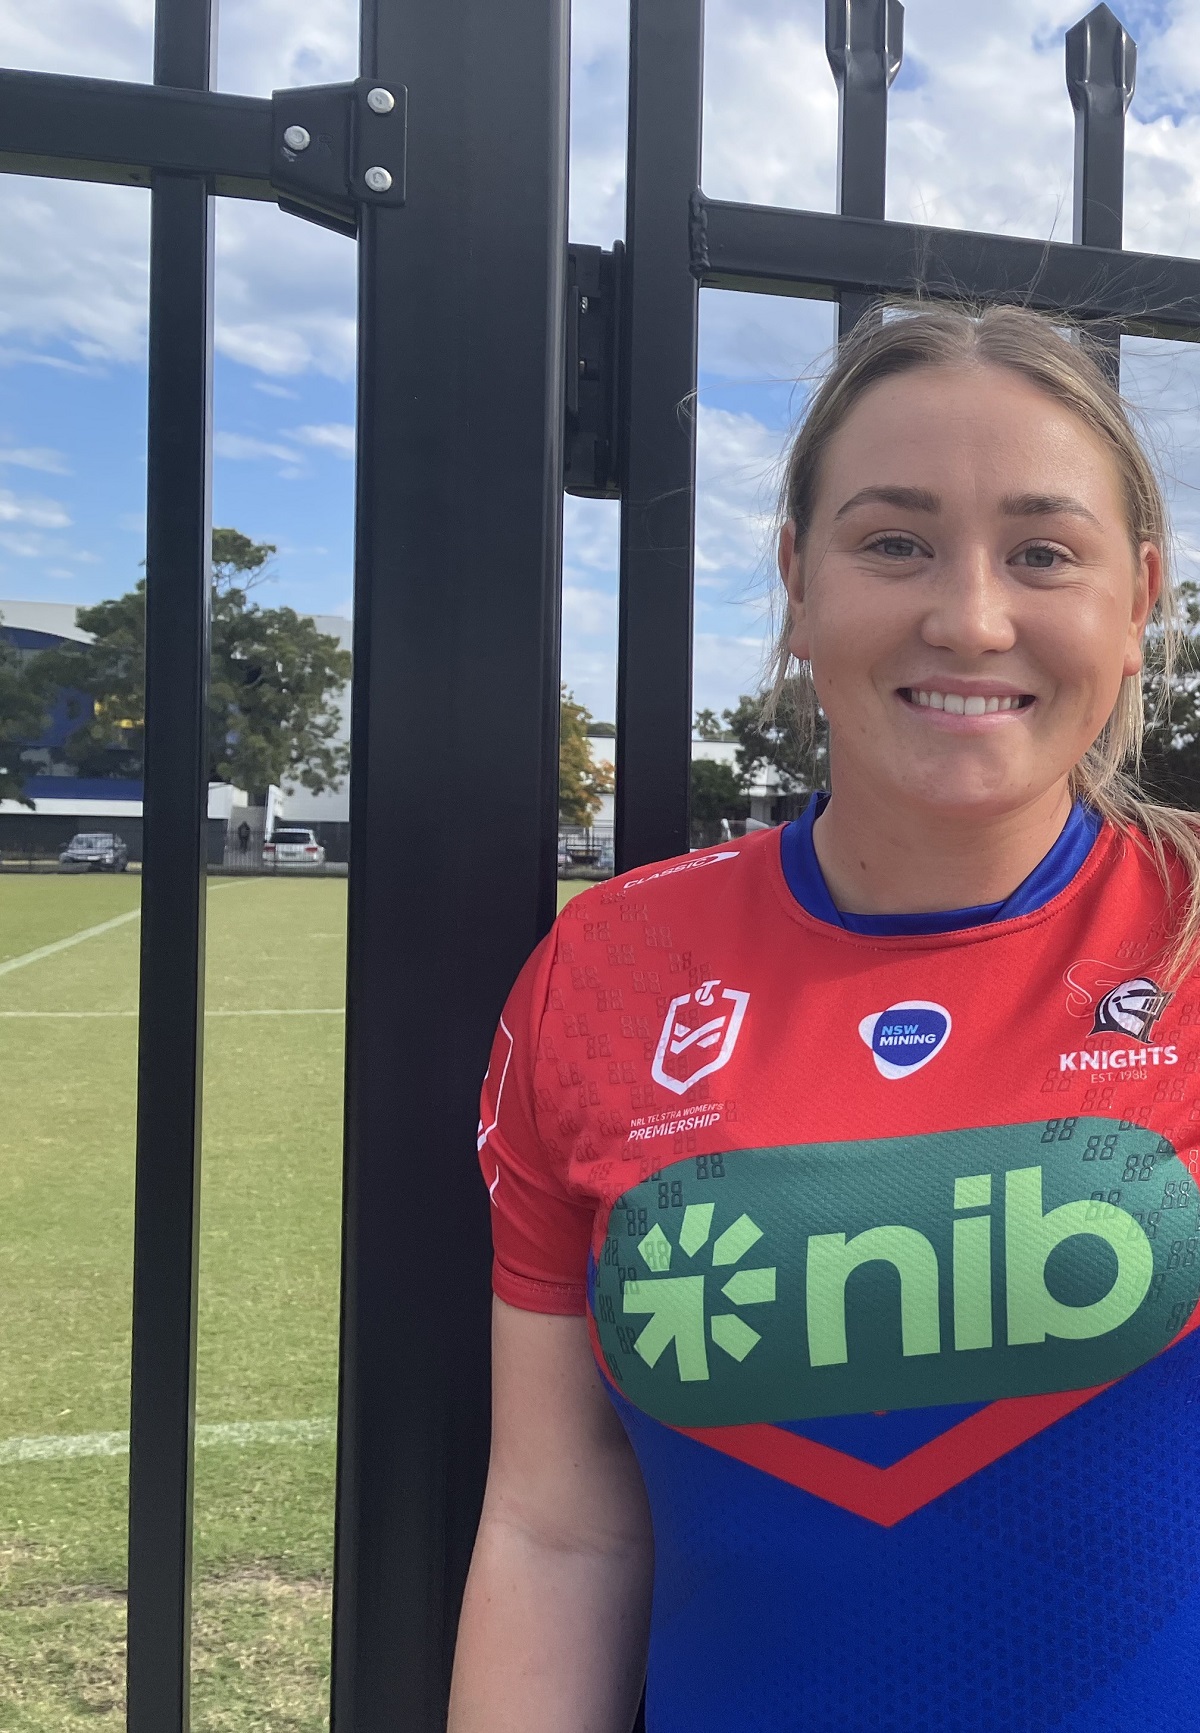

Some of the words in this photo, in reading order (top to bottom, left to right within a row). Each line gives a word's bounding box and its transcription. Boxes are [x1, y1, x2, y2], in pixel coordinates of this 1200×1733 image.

[623, 857, 708, 889] CLASSIC
[879, 1033, 937, 1047] MINING
[881, 1024, 919, 1036] NSW
[1059, 1045, 1179, 1072] KNIGHTS
[1091, 1072, 1116, 1083] EST.
[1119, 1069, 1148, 1082] 1988
[627, 1112, 721, 1143] PREMIERSHIP
[630, 1118, 646, 1128] NRL
[647, 1109, 682, 1124] TELSTRA
[683, 1103, 725, 1117] WOMEN'S
[806, 1164, 1154, 1368] nib
